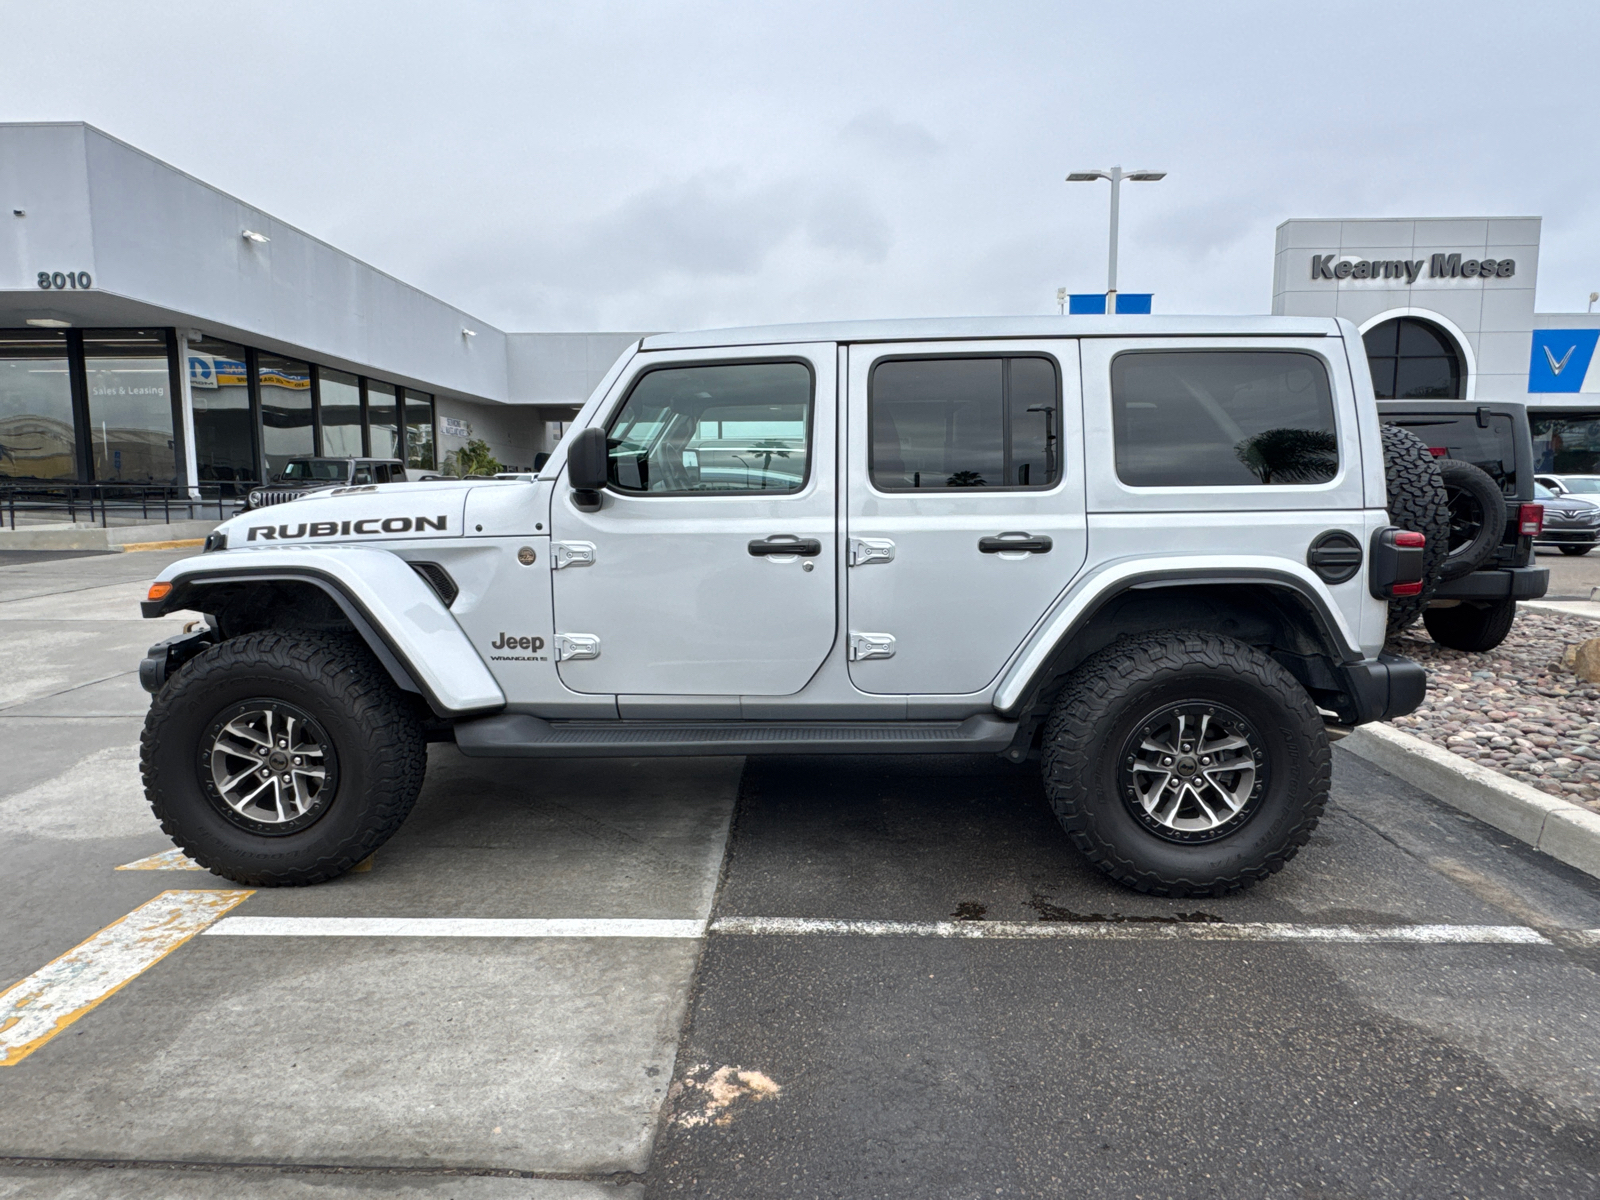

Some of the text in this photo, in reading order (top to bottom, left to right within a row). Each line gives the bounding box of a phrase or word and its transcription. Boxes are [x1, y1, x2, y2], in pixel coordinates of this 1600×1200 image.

[1311, 253, 1516, 284] Kearny Mesa
[37, 271, 92, 289] 8010
[92, 386, 164, 397] Sales & Leasing
[246, 514, 448, 542] RUBICON
[491, 632, 545, 653] Jeep
